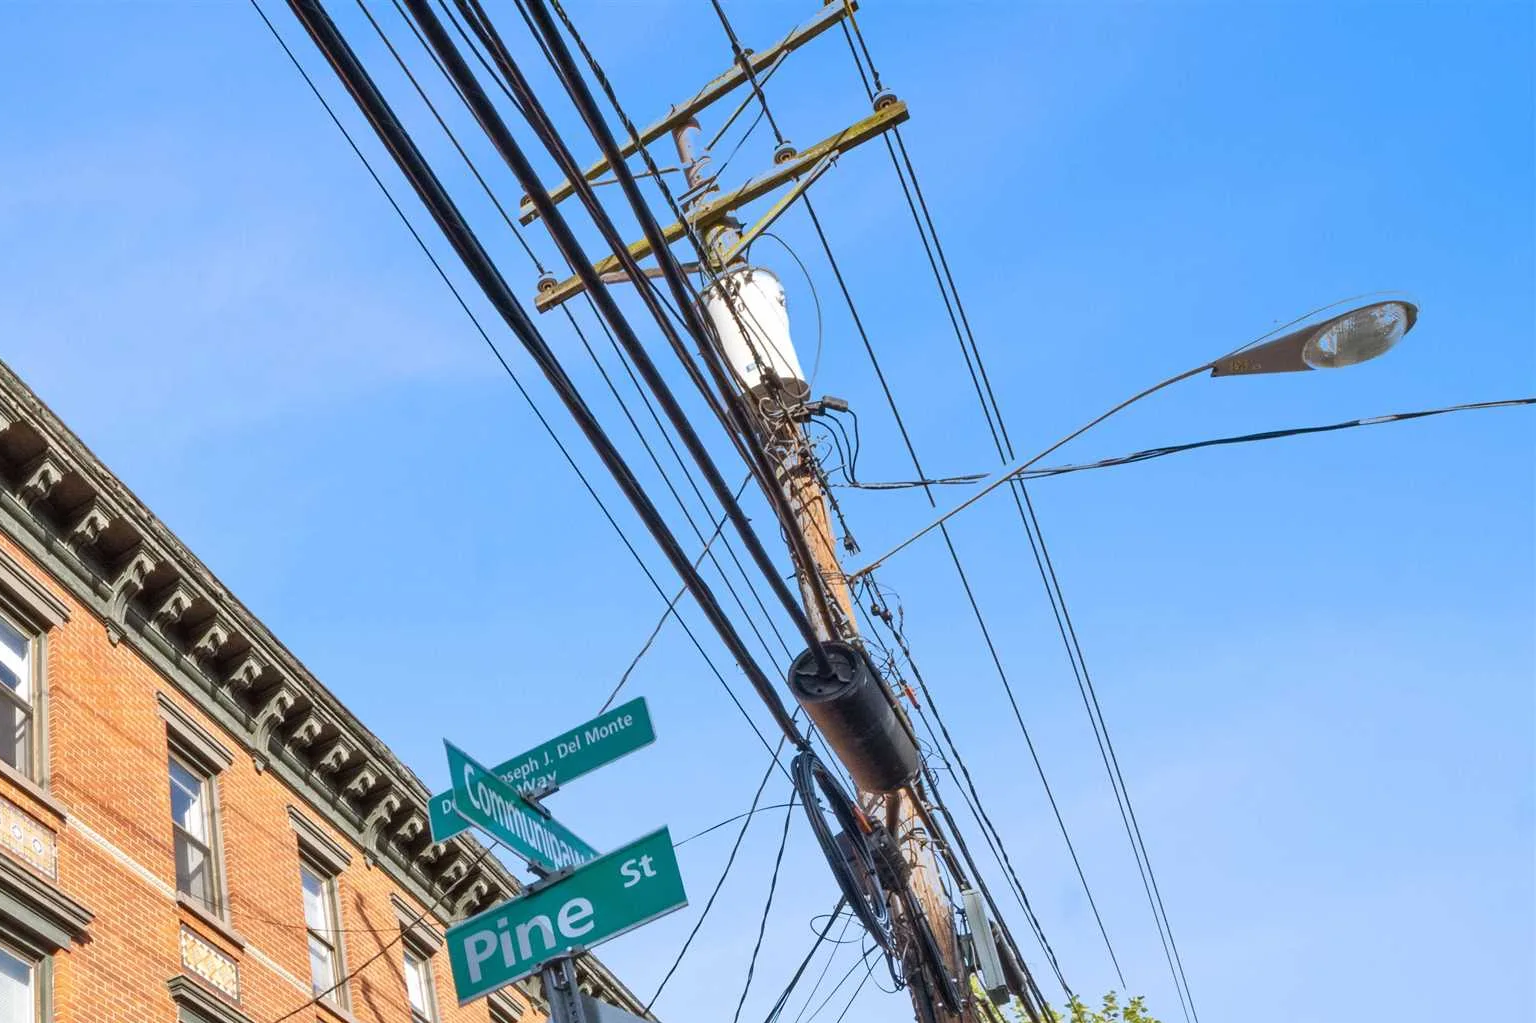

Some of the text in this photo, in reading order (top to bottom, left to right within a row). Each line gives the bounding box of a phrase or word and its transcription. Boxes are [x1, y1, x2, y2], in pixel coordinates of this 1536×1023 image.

[500, 757, 539, 783] oseph
[544, 751, 554, 768] J.
[557, 737, 582, 759] Del
[585, 712, 633, 744] Monte
[463, 853, 657, 983] Pine St
